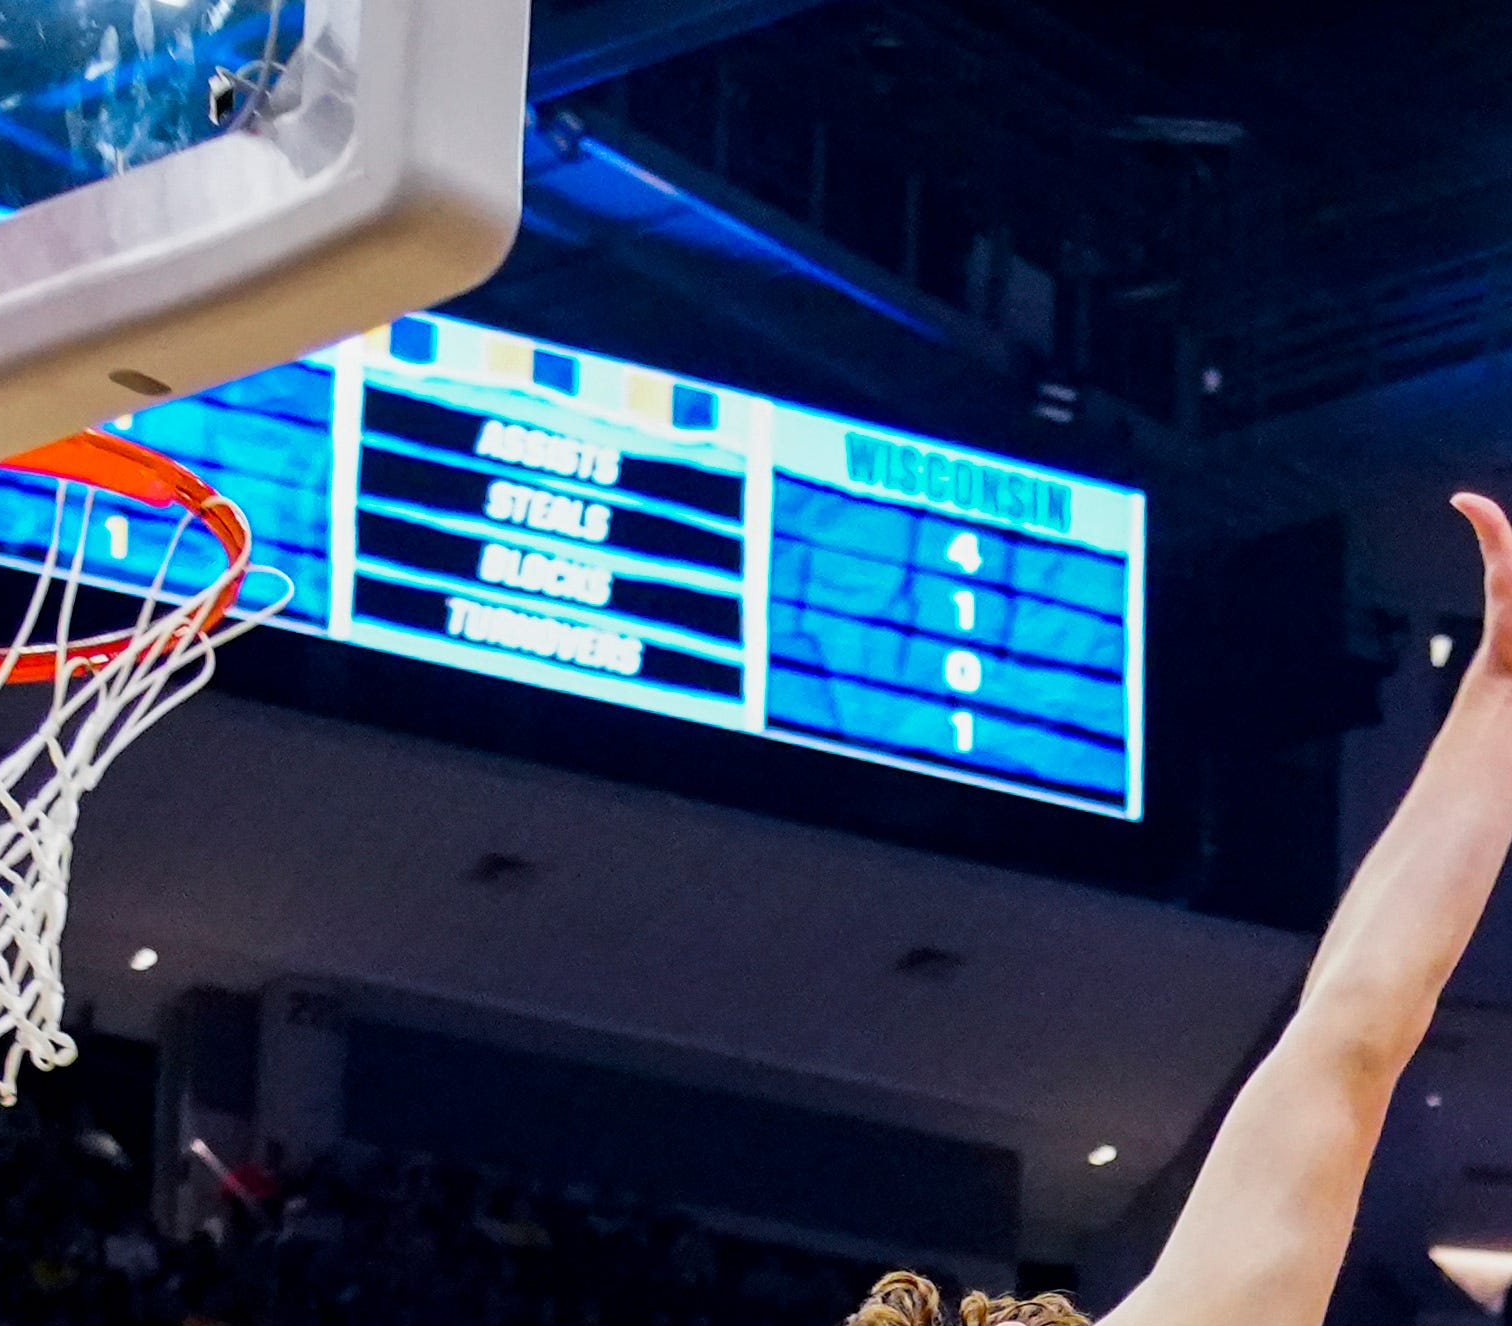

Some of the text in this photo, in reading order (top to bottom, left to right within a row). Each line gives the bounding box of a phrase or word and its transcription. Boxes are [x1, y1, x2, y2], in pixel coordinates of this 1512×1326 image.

[844, 430, 1073, 535] WISCONSIN
[484, 480, 612, 543] STEALS
[104, 515, 129, 560] 1
[946, 531, 983, 574] 4
[478, 542, 614, 607] BLOCKS
[952, 590, 976, 631] 1
[445, 596, 645, 676] TURNOVERS
[945, 649, 982, 693] 0
[950, 711, 974, 753] 1
